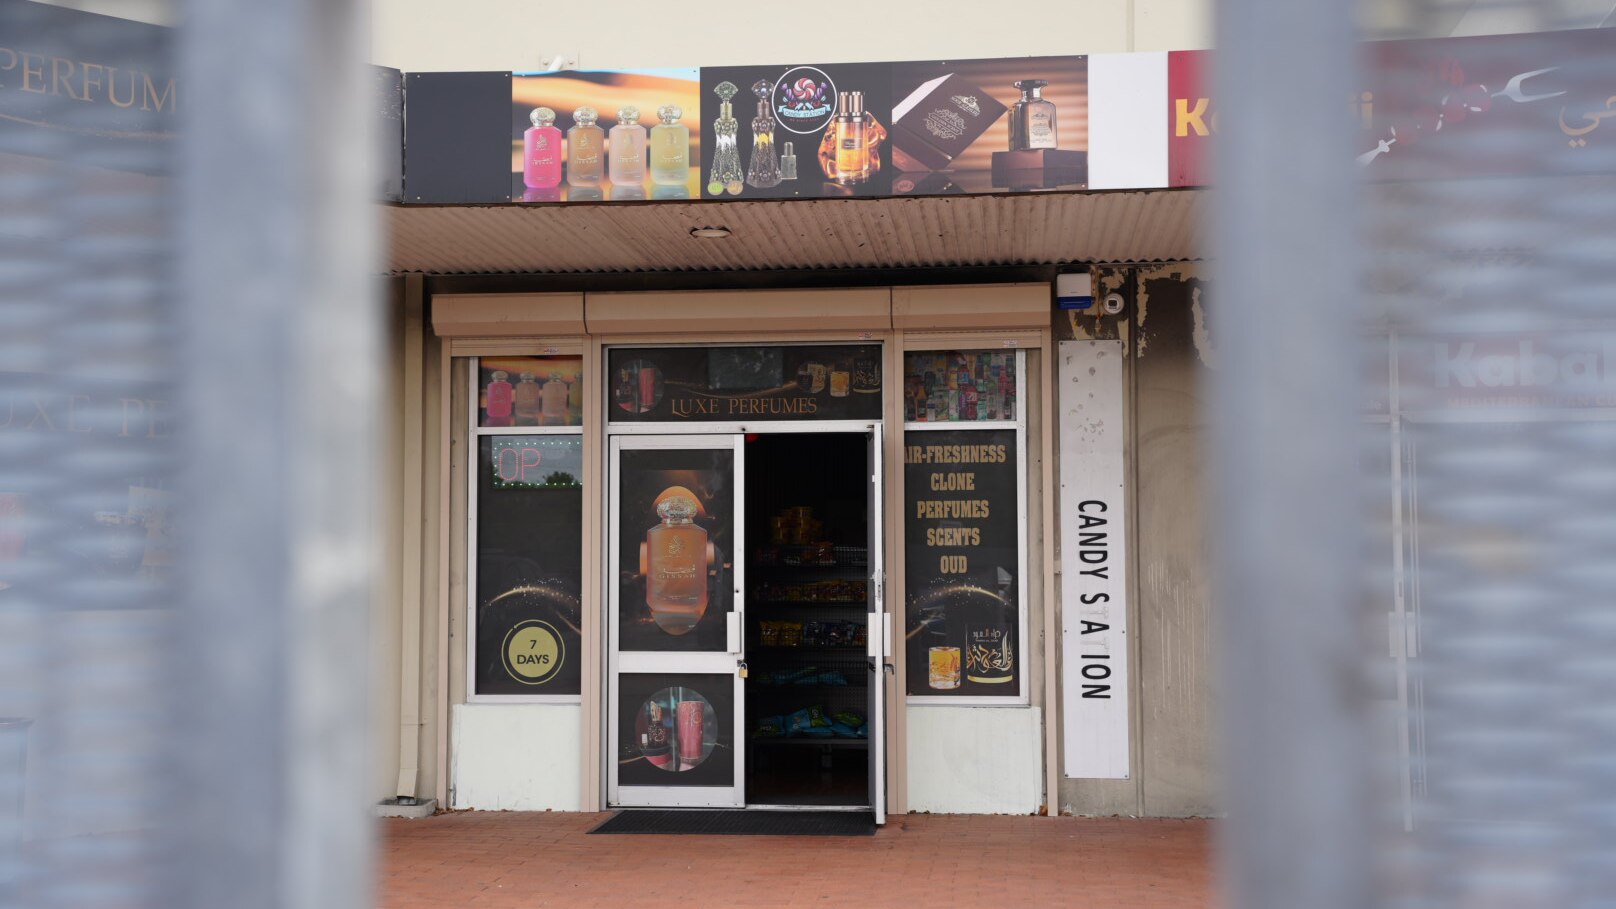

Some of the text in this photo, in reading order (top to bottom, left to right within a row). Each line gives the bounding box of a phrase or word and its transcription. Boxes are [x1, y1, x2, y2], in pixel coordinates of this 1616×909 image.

[671, 397, 818, 418] LUXE PERFUMES
[930, 472, 975, 491] CLONE
[916, 500, 990, 519] PERFUMES
[926, 527, 981, 546] SCENTS
[1078, 499, 1109, 580] CANDY
[940, 555, 968, 574] OUD
[529, 639, 538, 650] 7
[516, 654, 550, 665] DAYS
